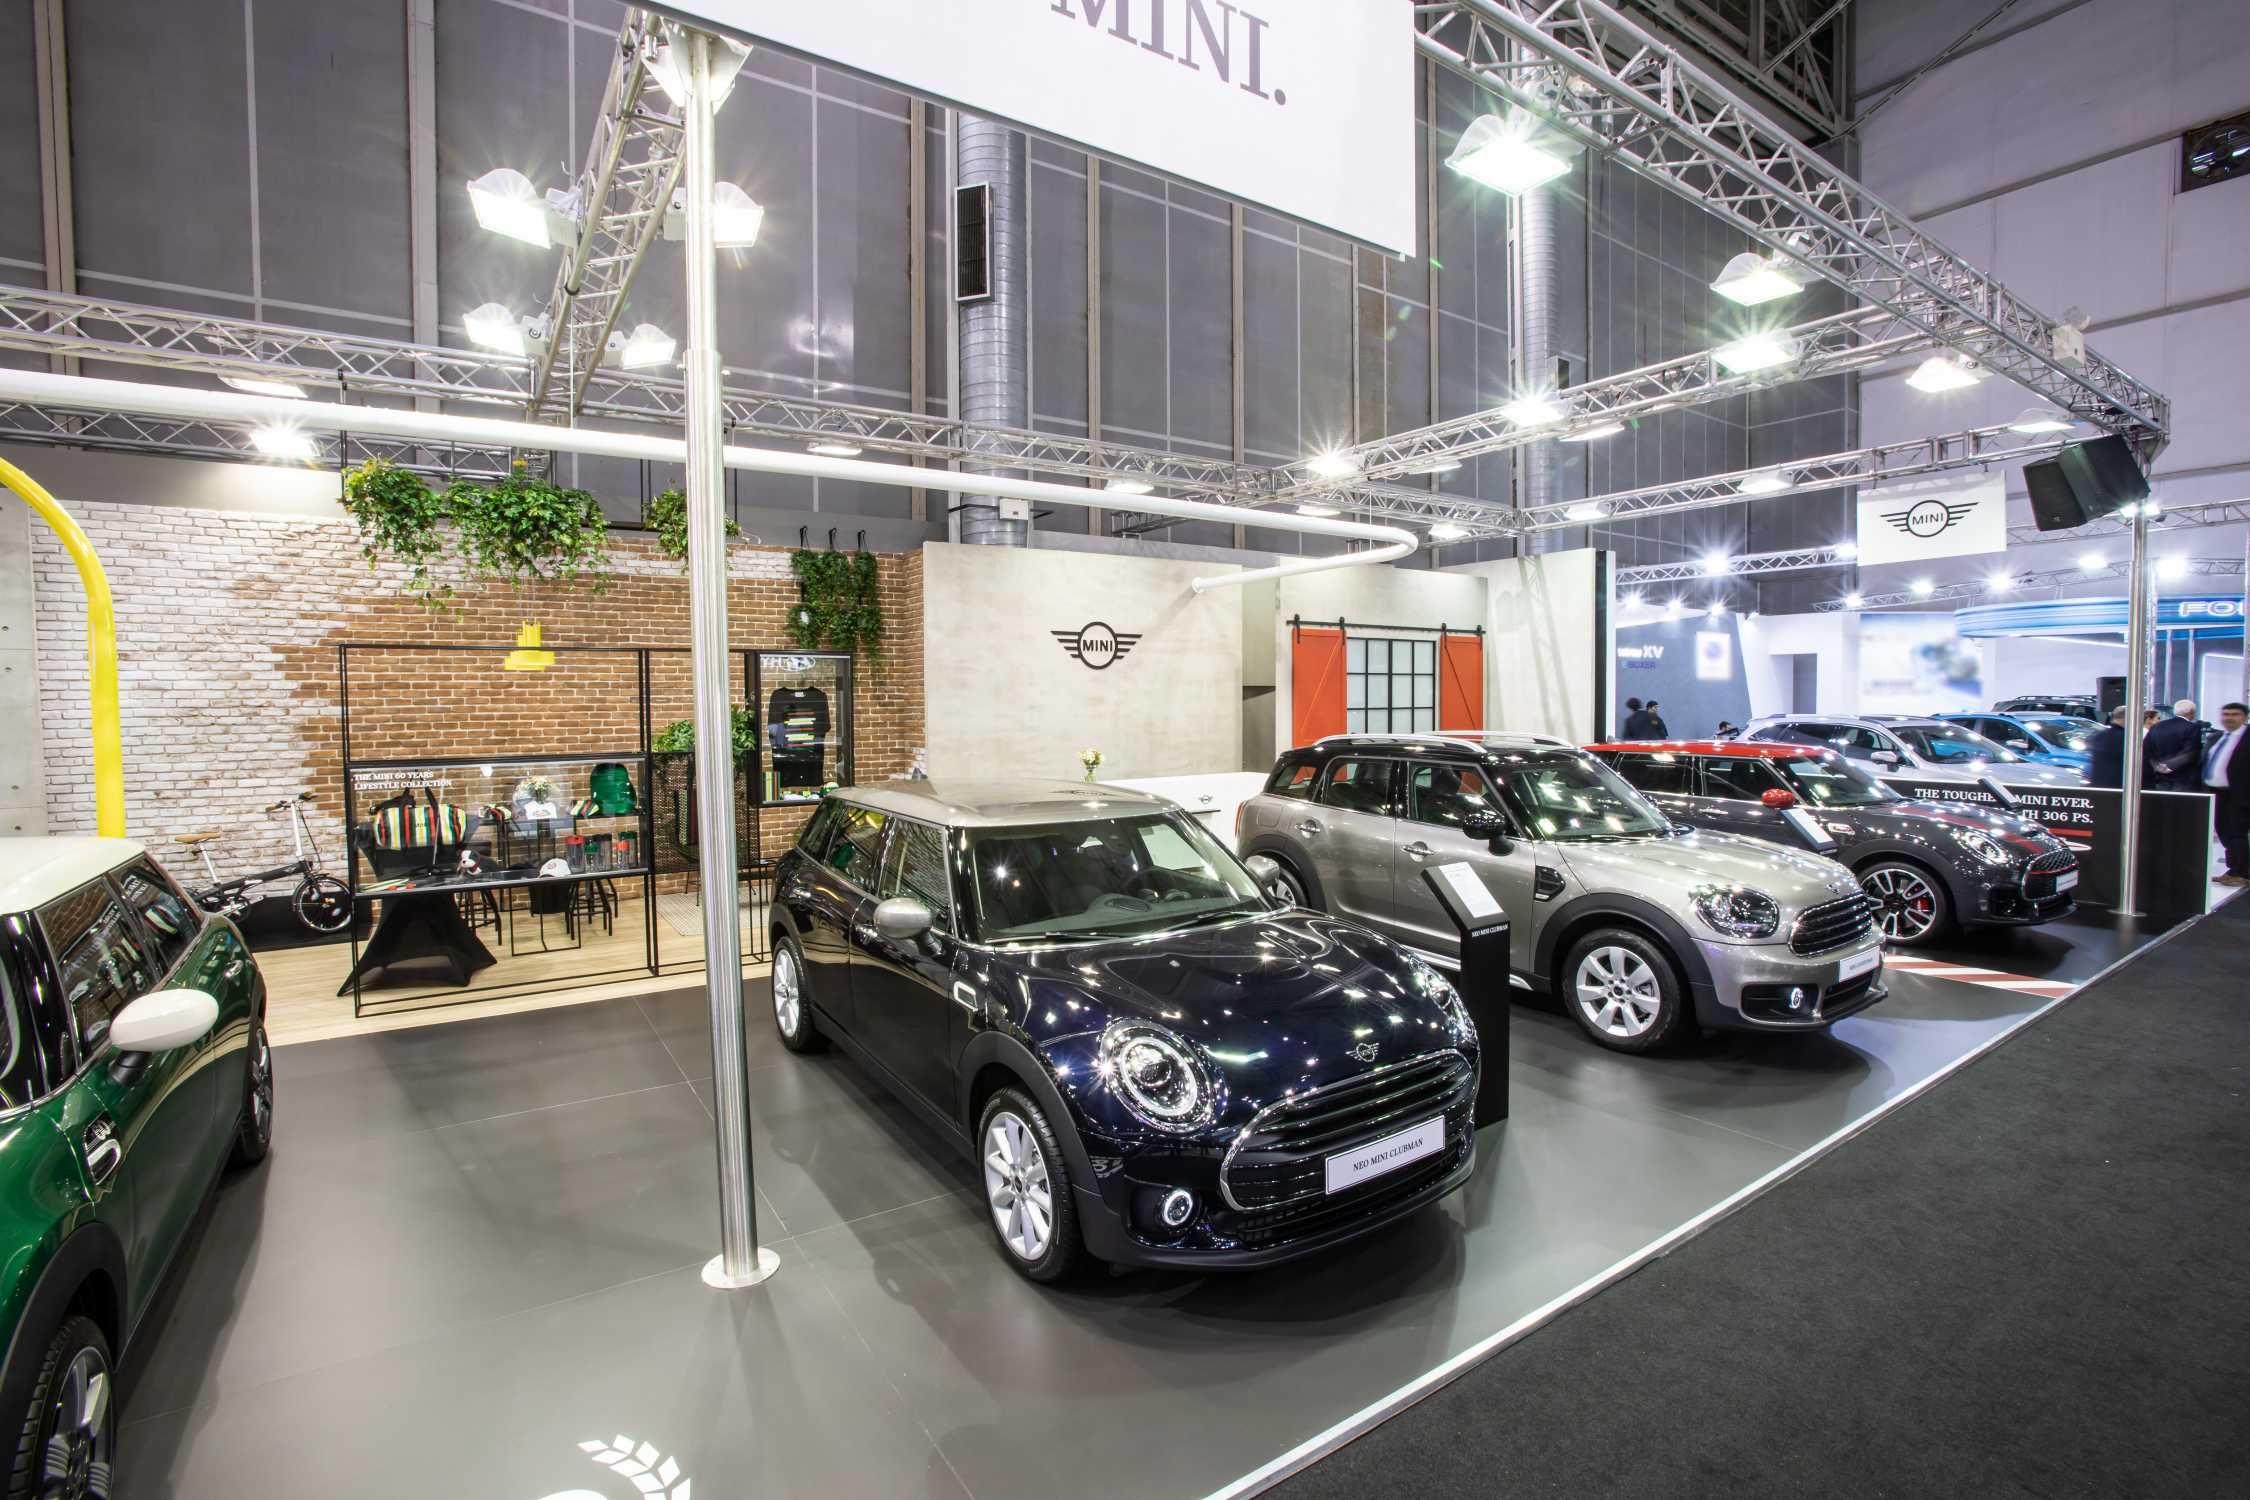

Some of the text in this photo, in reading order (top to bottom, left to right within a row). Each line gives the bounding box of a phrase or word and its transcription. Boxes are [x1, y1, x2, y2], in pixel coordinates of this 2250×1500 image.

[1913, 513, 1943, 525] MINI
[2179, 600, 2244, 617] FO
[1082, 639, 1113, 652] MINI
[1643, 645, 1664, 658] XV
[407, 771, 434, 779] YEARS
[1914, 788, 1940, 799] THE
[1942, 790, 1997, 802] TOUGHE
[2051, 796, 2095, 809] EVER.
[2042, 810, 2068, 822] 306
[2072, 812, 2094, 824] PS.
[1353, 1138, 1423, 1172] NEO MINI CLUBMAN
